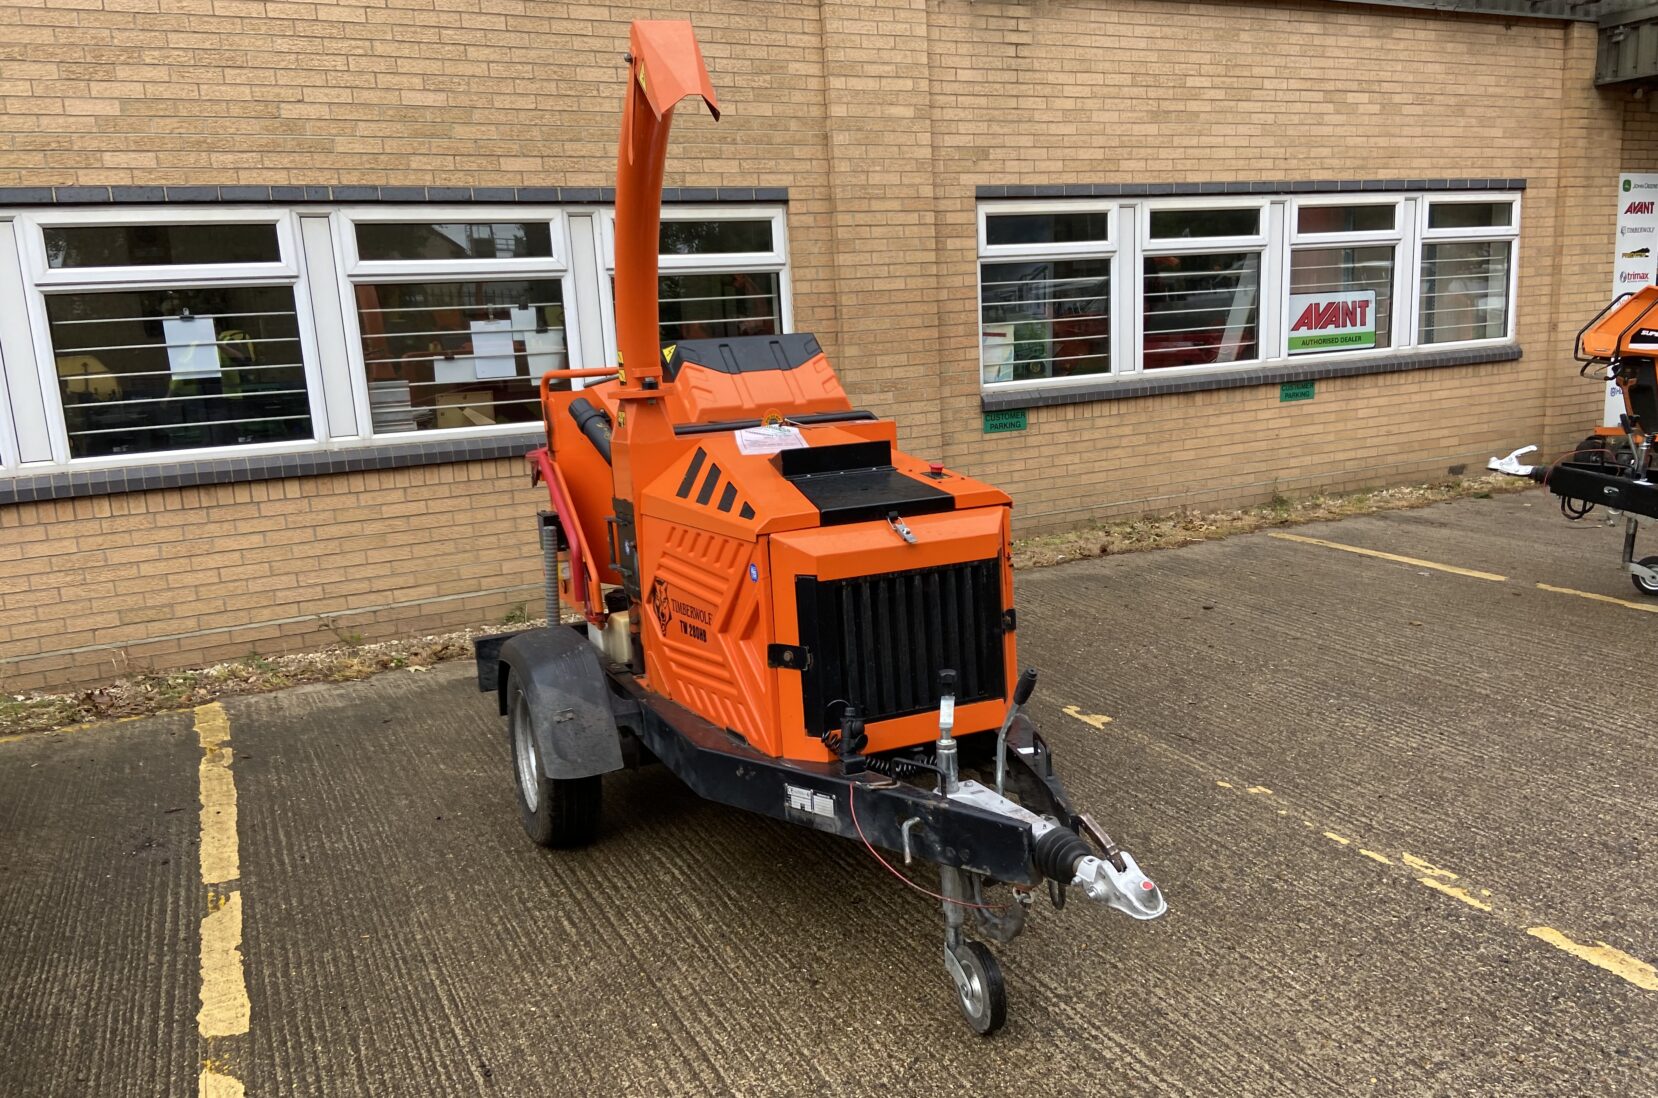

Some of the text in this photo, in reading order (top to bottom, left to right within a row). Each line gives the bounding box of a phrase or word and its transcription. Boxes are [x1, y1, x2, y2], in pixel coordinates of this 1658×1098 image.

[1624, 201, 1655, 215] AVANT
[1627, 272, 1649, 280] trimax
[1291, 299, 1370, 332] AVANT
[1301, 335, 1362, 346] AUTHORISED DEALER
[1284, 390, 1311, 399] PARKING
[985, 410, 1026, 422] CUSTOMER
[990, 420, 1022, 430] PARKING
[671, 598, 713, 626] TIMBERWOLF
[679, 620, 689, 635] TW
